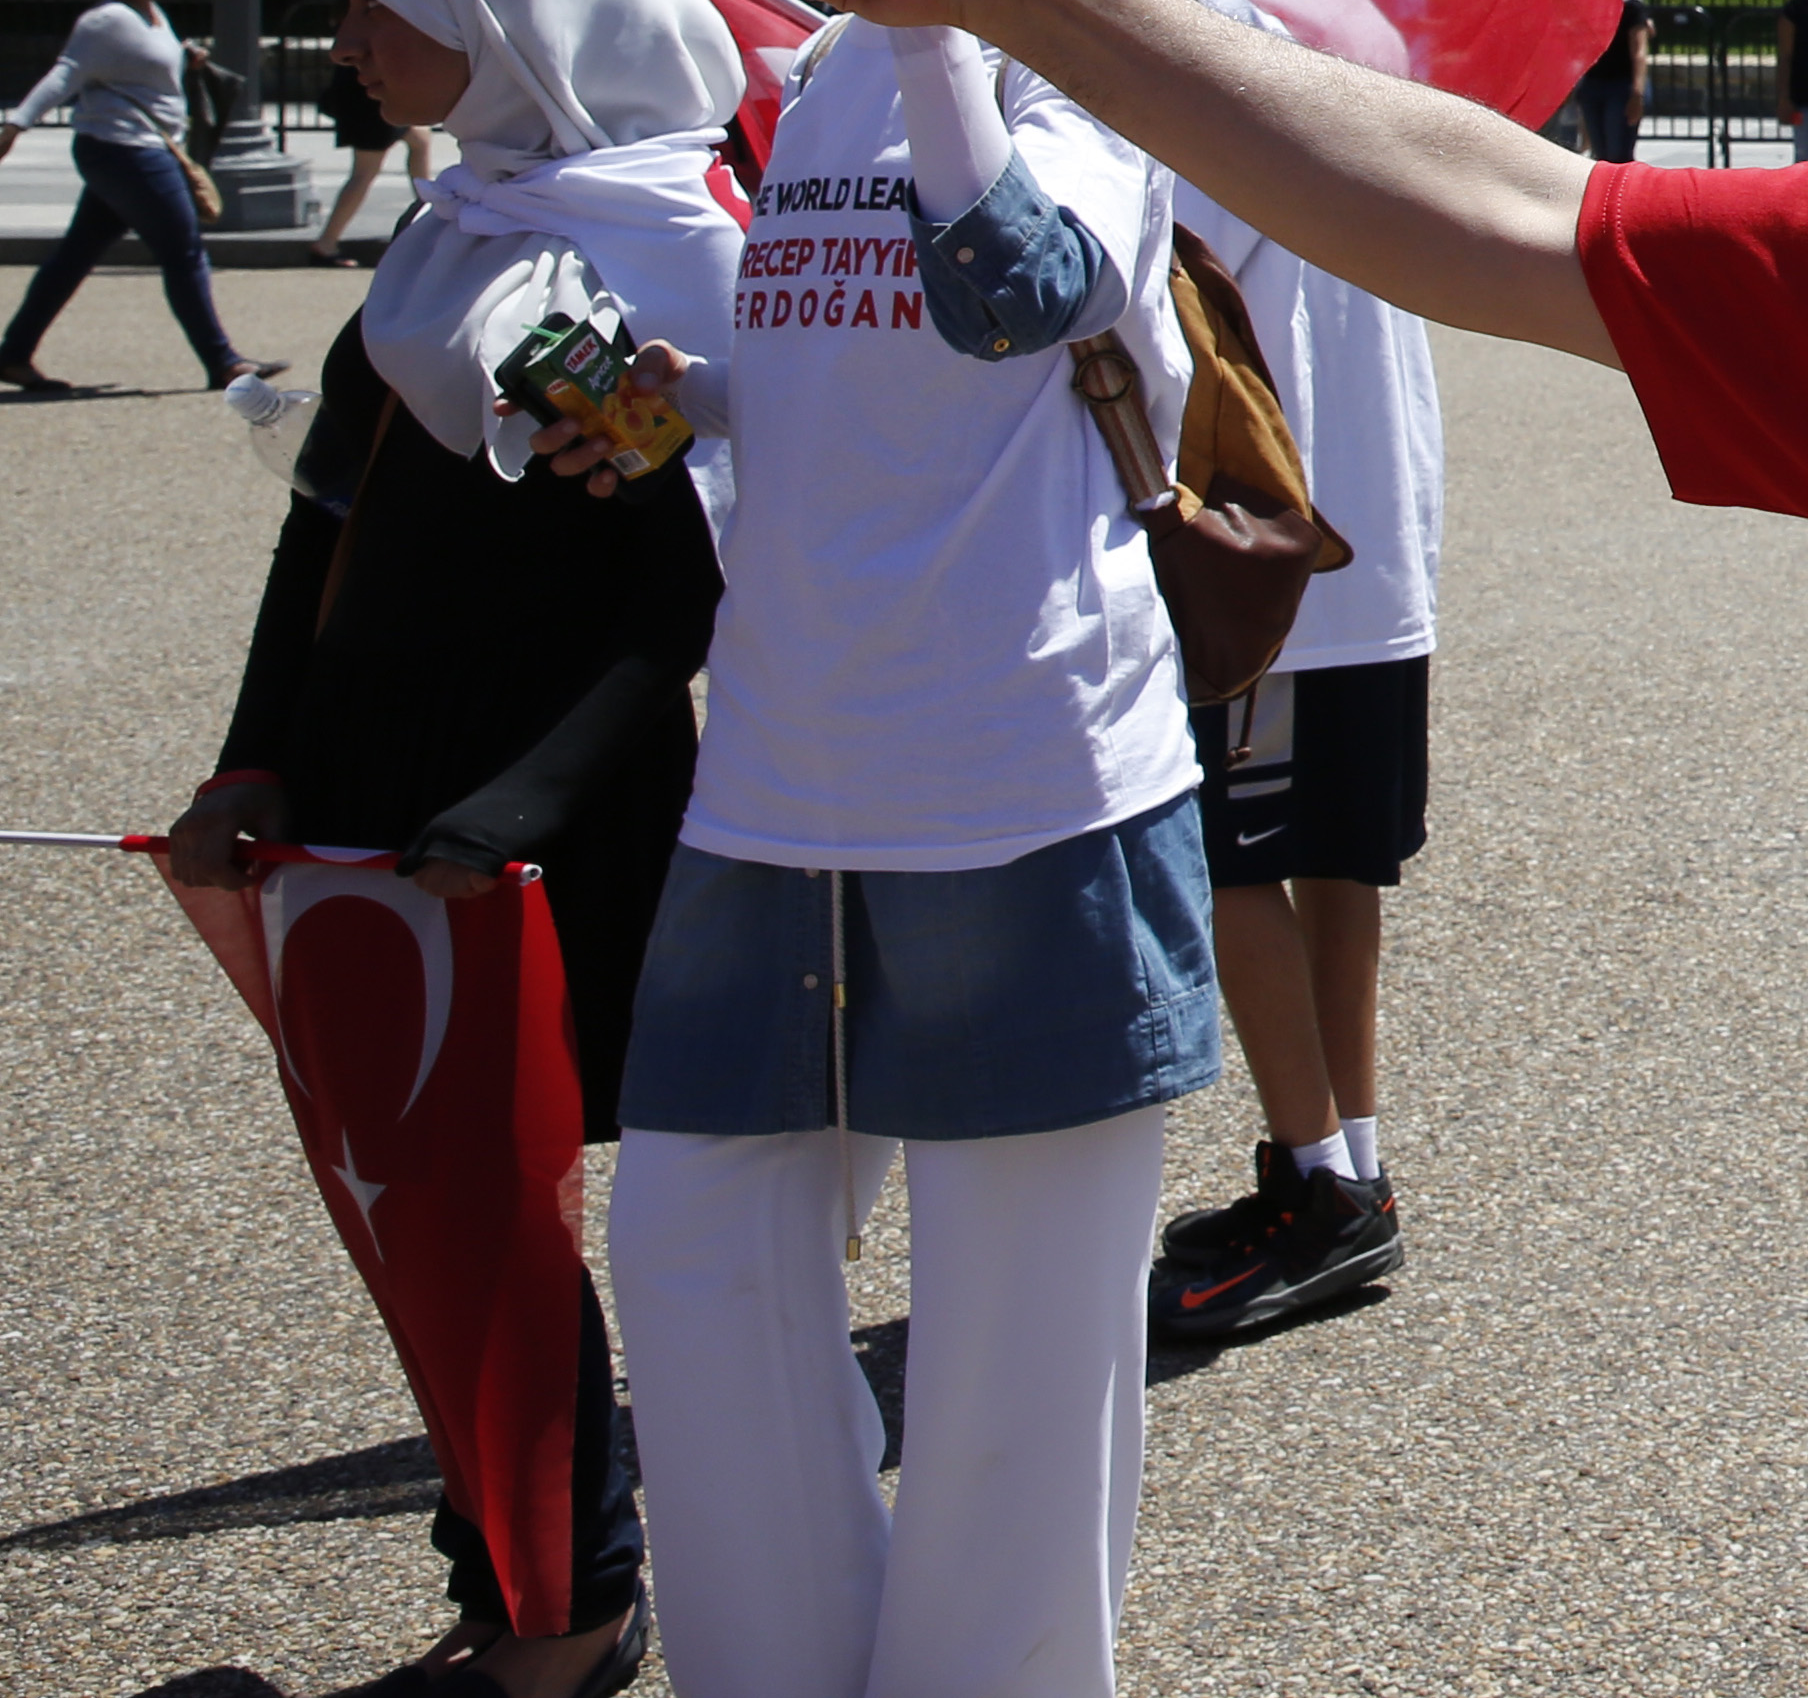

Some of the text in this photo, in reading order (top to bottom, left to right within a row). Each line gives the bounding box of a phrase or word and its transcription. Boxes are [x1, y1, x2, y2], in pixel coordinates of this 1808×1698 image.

[777, 178, 850, 215] WORLD
[853, 177, 908, 212] LEA
[739, 238, 816, 279] RECEP
[735, 279, 922, 330] ERDOĞAN
